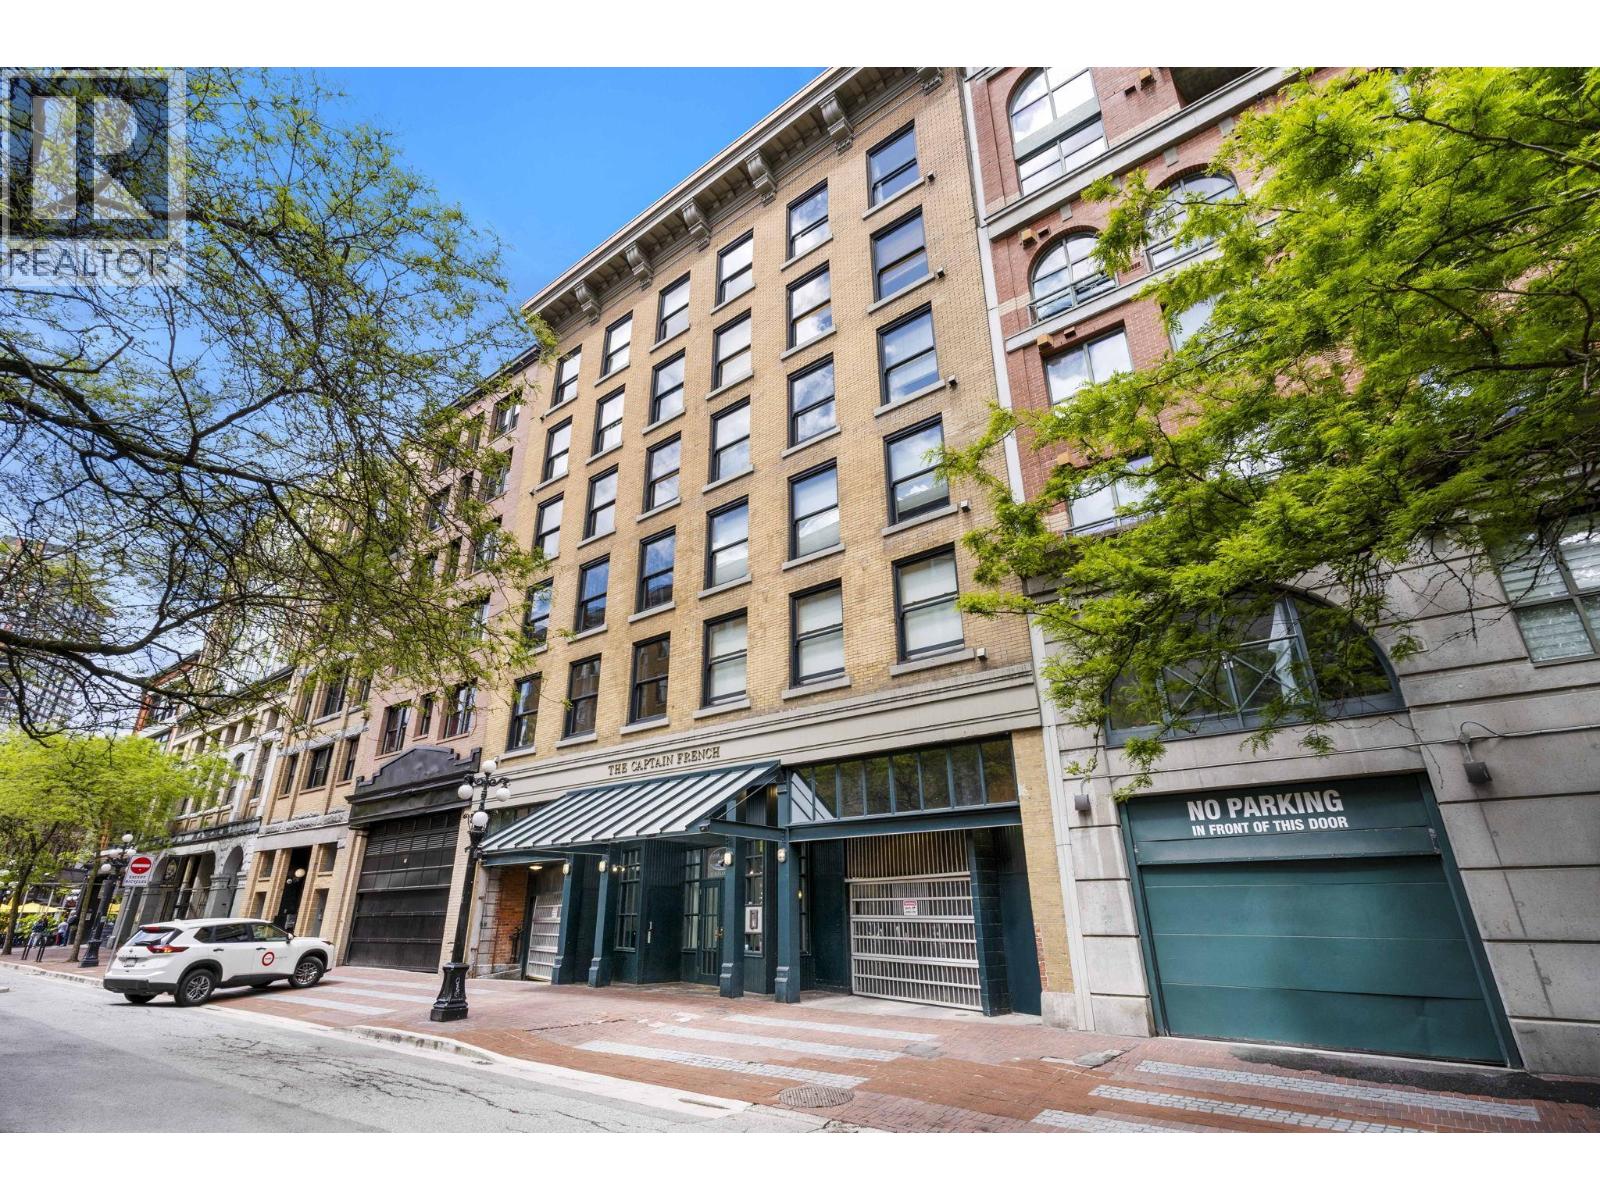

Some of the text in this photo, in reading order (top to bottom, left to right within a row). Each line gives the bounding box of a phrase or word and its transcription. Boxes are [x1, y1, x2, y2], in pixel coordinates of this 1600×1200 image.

[608, 746, 721, 776] THE CAPTAIN FRENCH
[1186, 789, 1344, 821] NO PARKING
[1192, 816, 1349, 837] IN FRONT OF THIS DOOR
